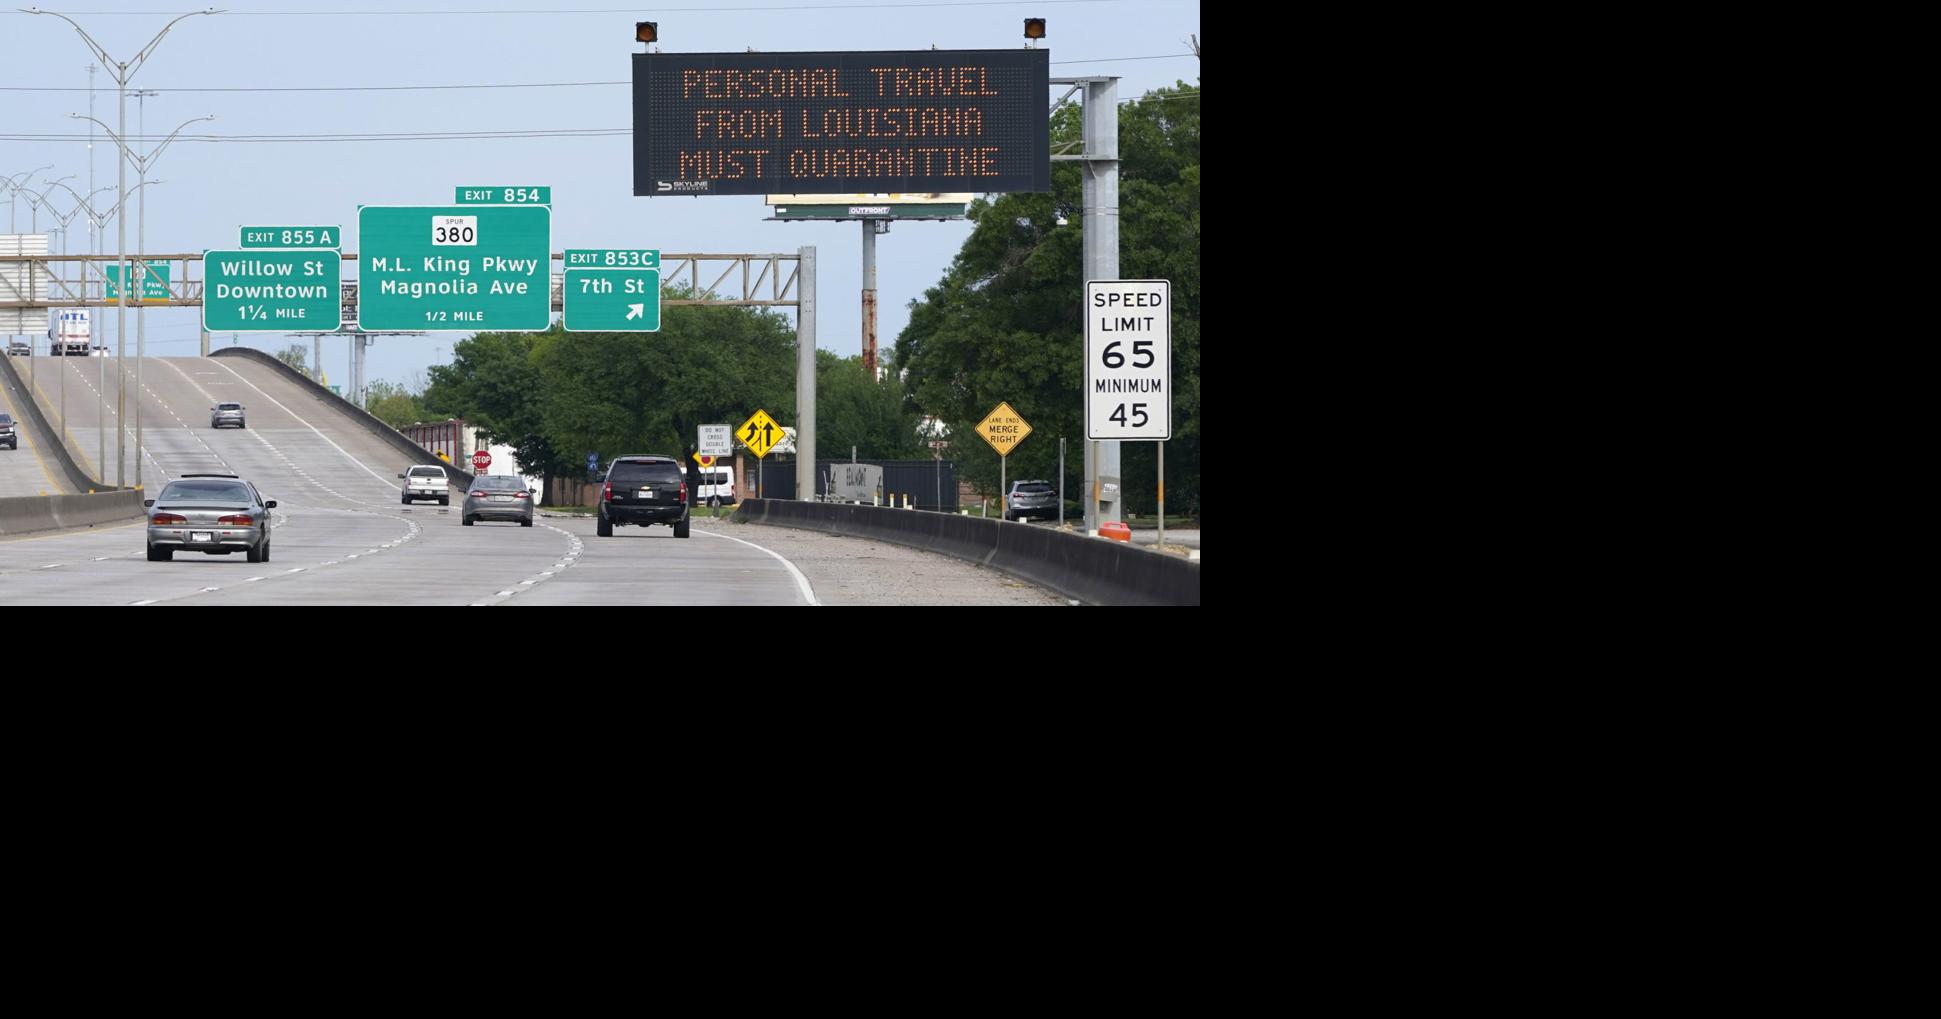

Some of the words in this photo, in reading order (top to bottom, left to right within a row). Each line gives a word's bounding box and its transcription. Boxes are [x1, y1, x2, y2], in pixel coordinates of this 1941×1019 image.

[683, 69, 848, 98] PERSONAL
[870, 66, 999, 96] TRAVEL
[697, 109, 783, 139] FROM
[802, 107, 982, 138] LOUISIANA
[680, 149, 769, 180] MUST
[790, 147, 1000, 178] QUARANTINE
[466, 191, 492, 200] EXIT
[504, 188, 540, 202] 854
[248, 233, 274, 242] EXIT
[435, 227, 474, 243] 380
[372, 257, 411, 272] M.L.
[424, 256, 470, 276] King
[483, 256, 538, 276] Pkwy
[571, 254, 598, 263] EXIT
[605, 252, 653, 265] 853C
[221, 260, 293, 276] Willow
[304, 260, 324, 276] St
[217, 284, 327, 299] Downtown
[381, 279, 478, 298] Magnolia
[490, 280, 528, 294] Ave
[580, 278, 613, 294] 7th
[624, 279, 645, 294] St
[1094, 293, 1162, 307] SPEED
[276, 308, 306, 318] MILE
[425, 311, 447, 321] 1/2
[454, 311, 483, 321] MILE
[1102, 317, 1155, 332] LIMIT
[1102, 341, 1155, 369] 65
[1096, 379, 1162, 393] MINIMUM
[1109, 403, 1149, 428] 45
[989, 425, 1019, 434] MERGE
[473, 456, 490, 464] STOP
